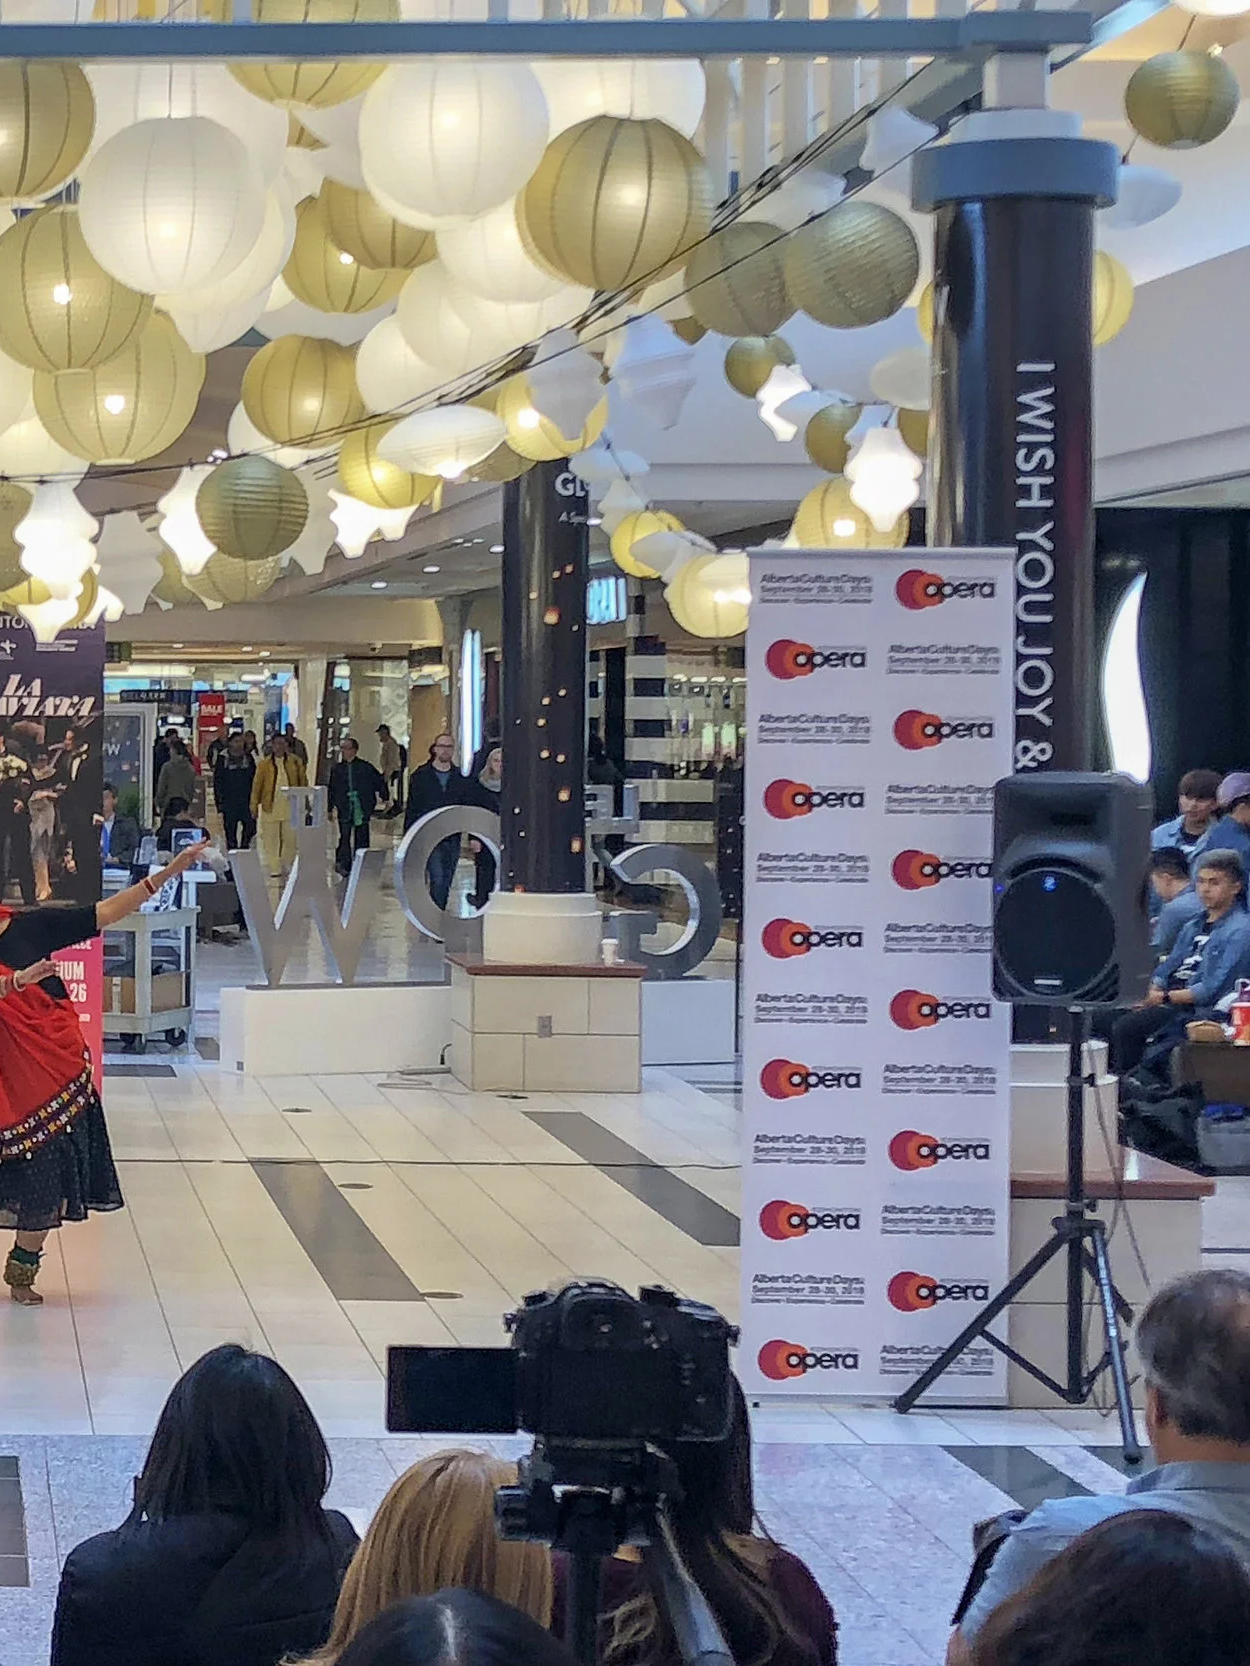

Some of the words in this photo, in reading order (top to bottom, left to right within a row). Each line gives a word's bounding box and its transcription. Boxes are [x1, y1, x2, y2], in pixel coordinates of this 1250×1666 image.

[1016, 361, 1055, 373] I
[1015, 386, 1055, 509] WISH
[1014, 521, 1054, 625] YOU
[924, 582, 995, 603] opera
[795, 651, 866, 672] opera
[3, 673, 42, 697] LA
[1014, 634, 1053, 727] JOY
[200, 704, 223, 716] SALE
[922, 722, 993, 743] opera
[1014, 739, 1053, 769] &
[793, 791, 864, 812] opera
[920, 862, 991, 883] opera
[791, 931, 862, 952] opera
[69, 983, 87, 1002] 26
[919, 1002, 990, 1023] opera
[790, 1072, 861, 1093] opera
[918, 1143, 989, 1164] opera
[789, 1213, 860, 1234] opera
[917, 1284, 988, 1305] opera
[787, 1352, 858, 1373] opera
